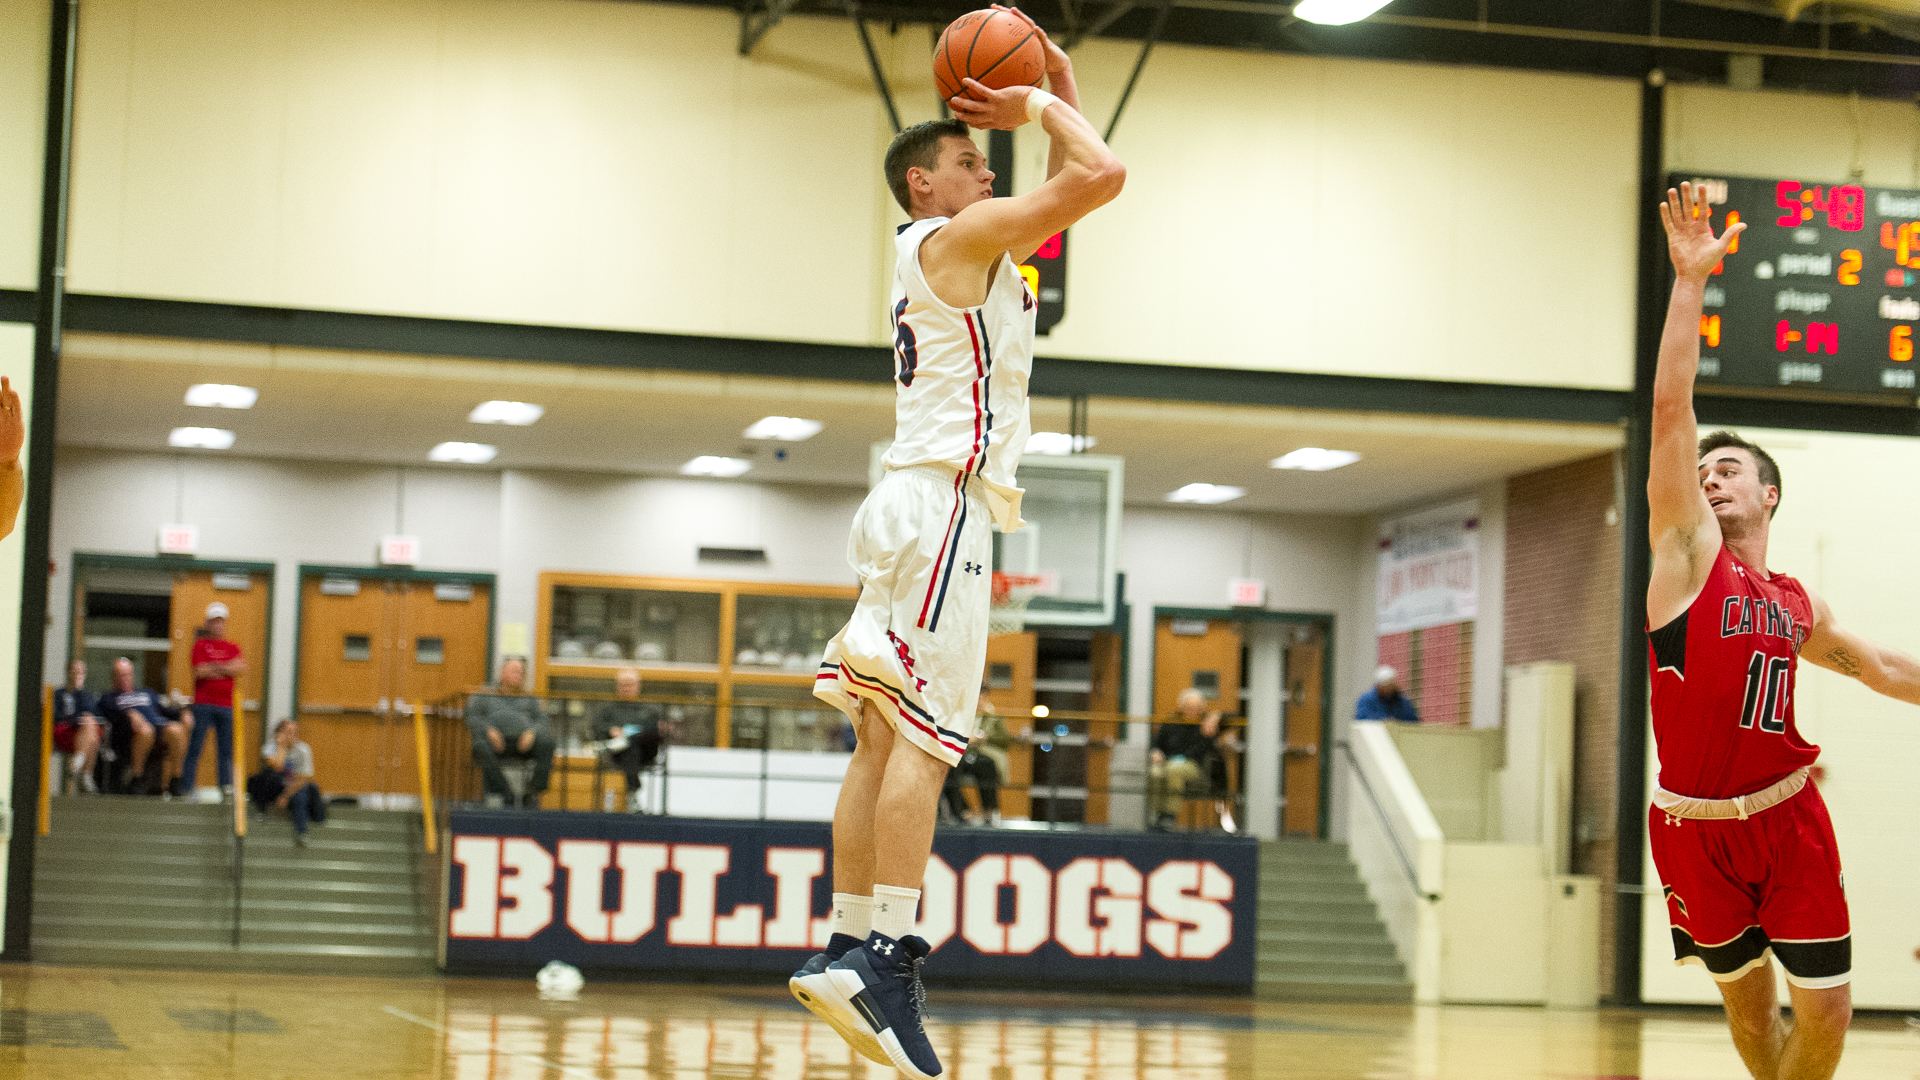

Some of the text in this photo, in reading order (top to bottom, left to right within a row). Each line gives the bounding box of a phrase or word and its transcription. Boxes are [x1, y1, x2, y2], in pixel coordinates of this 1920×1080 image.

[1776, 180, 1865, 231] 5:48
[1837, 249, 1863, 286] 2
[1889, 325, 1914, 362] 6
[1739, 650, 1790, 734] 10
